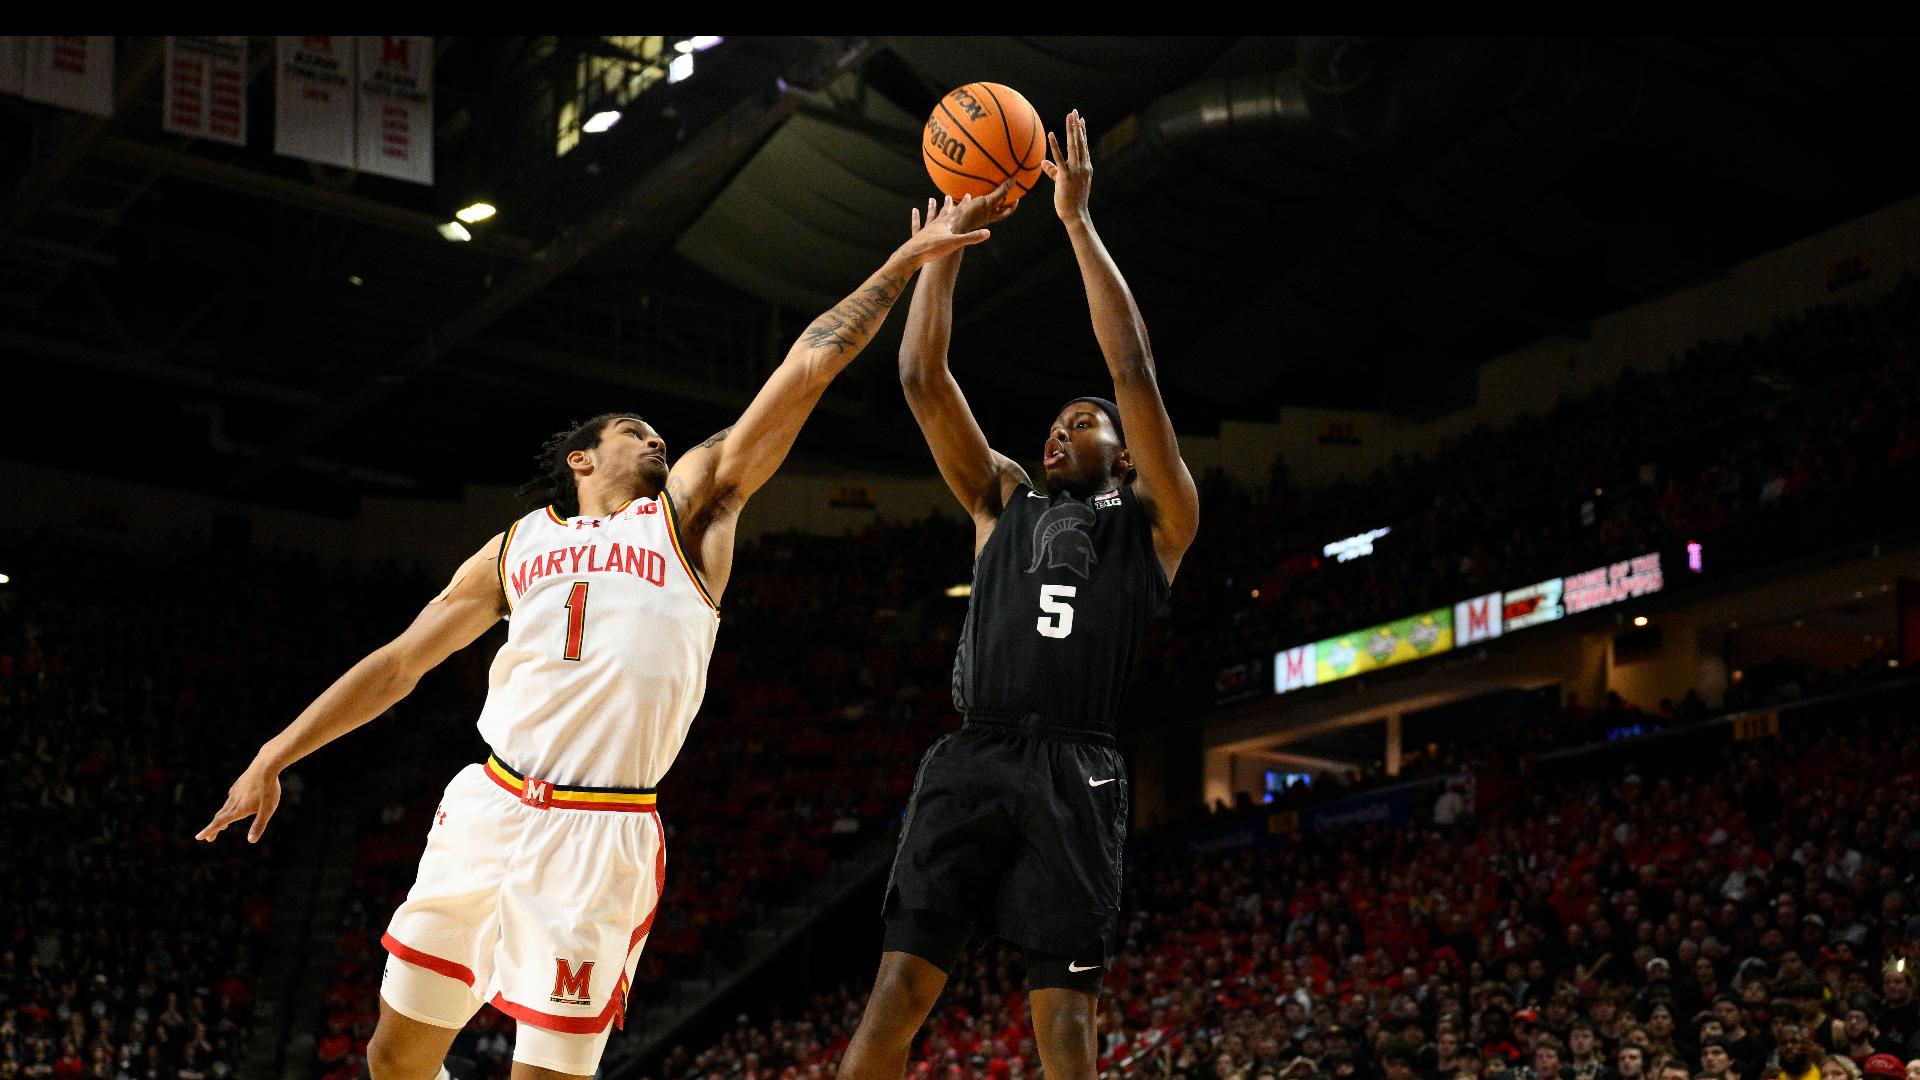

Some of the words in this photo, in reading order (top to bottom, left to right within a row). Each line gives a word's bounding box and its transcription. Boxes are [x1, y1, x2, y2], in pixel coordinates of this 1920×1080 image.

[511, 543, 666, 600] MARYLAND
[564, 582, 590, 661] 1
[1036, 584, 1077, 639] 5
[1467, 598, 1490, 640] M
[1286, 649, 1305, 682] M
[526, 779, 547, 803] M
[551, 957, 596, 999] M
